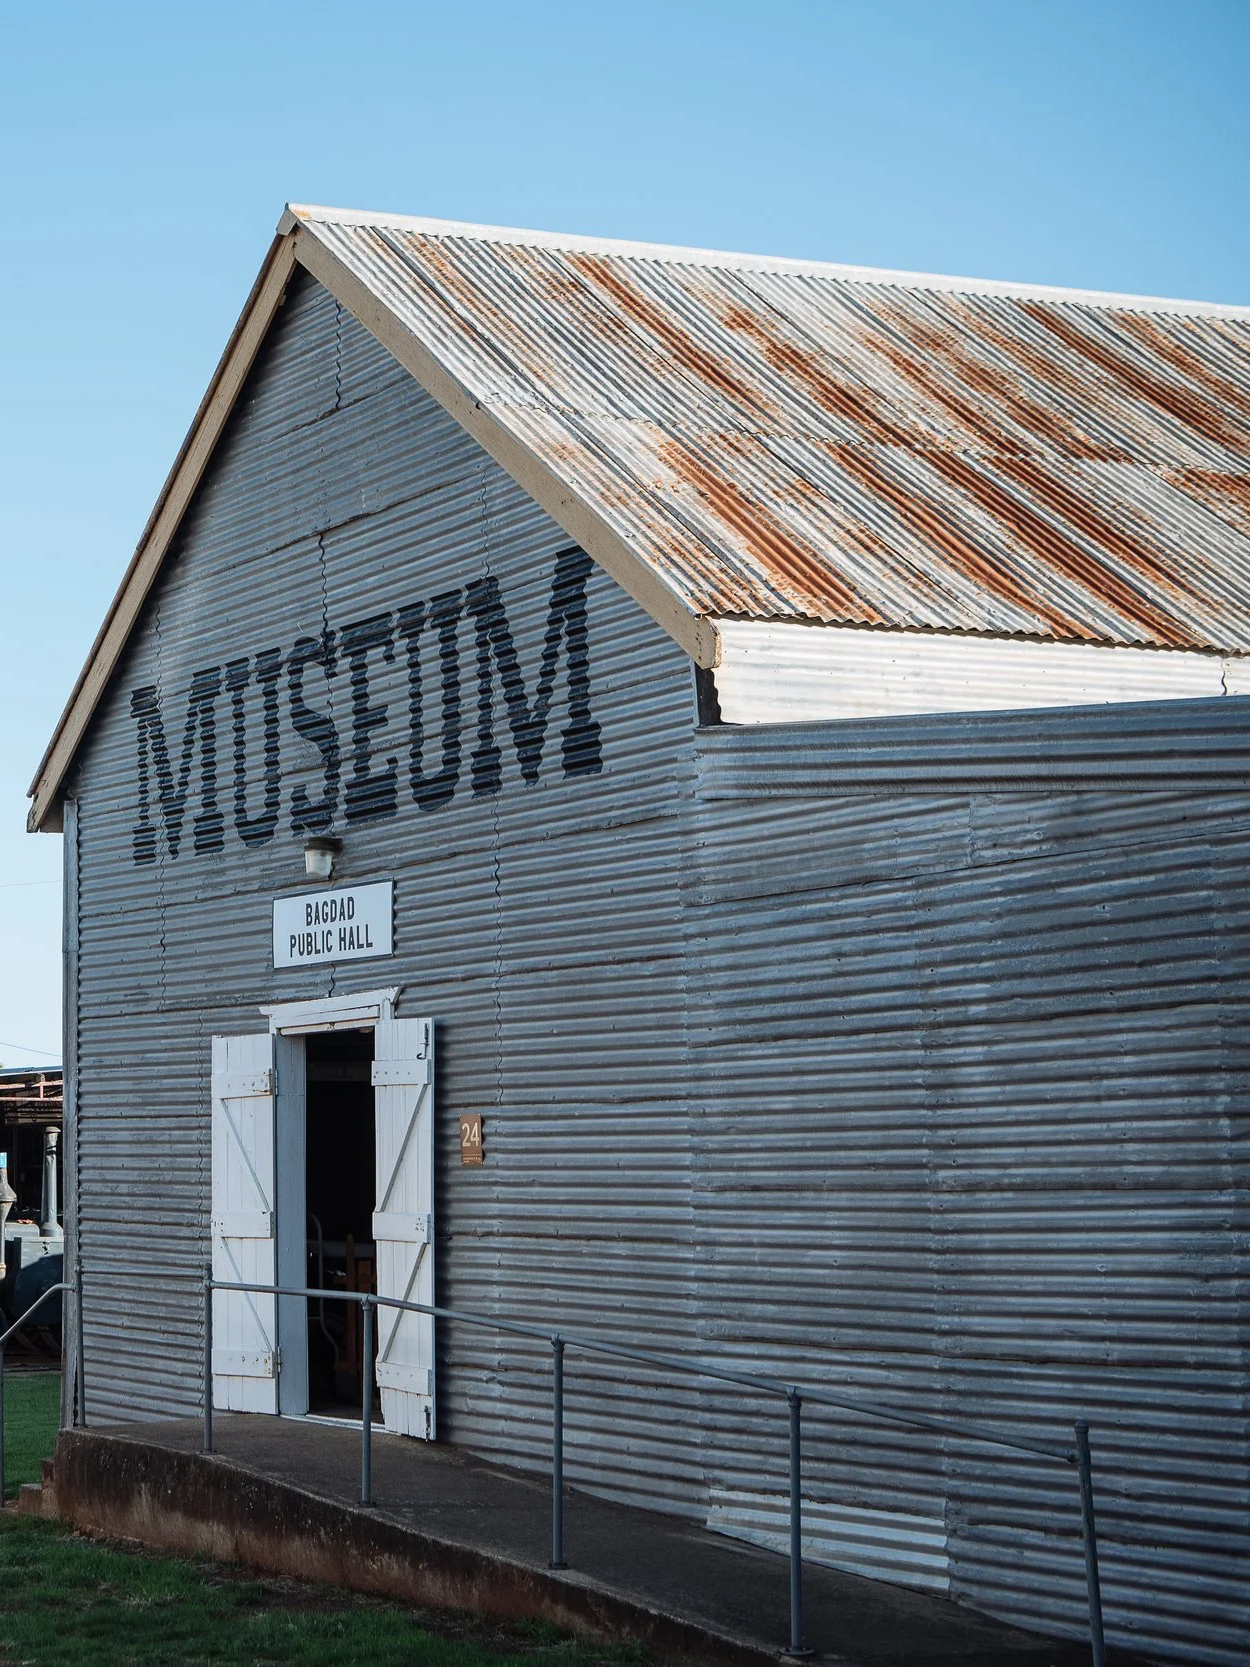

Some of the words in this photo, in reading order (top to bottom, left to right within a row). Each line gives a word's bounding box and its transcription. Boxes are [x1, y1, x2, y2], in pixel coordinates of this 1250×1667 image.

[130, 545, 603, 866] MUSEUM
[305, 896, 355, 926] BAGDAD
[290, 929, 333, 958] PUBLIC
[338, 924, 374, 952] HALL
[461, 1122, 480, 1147] 24
